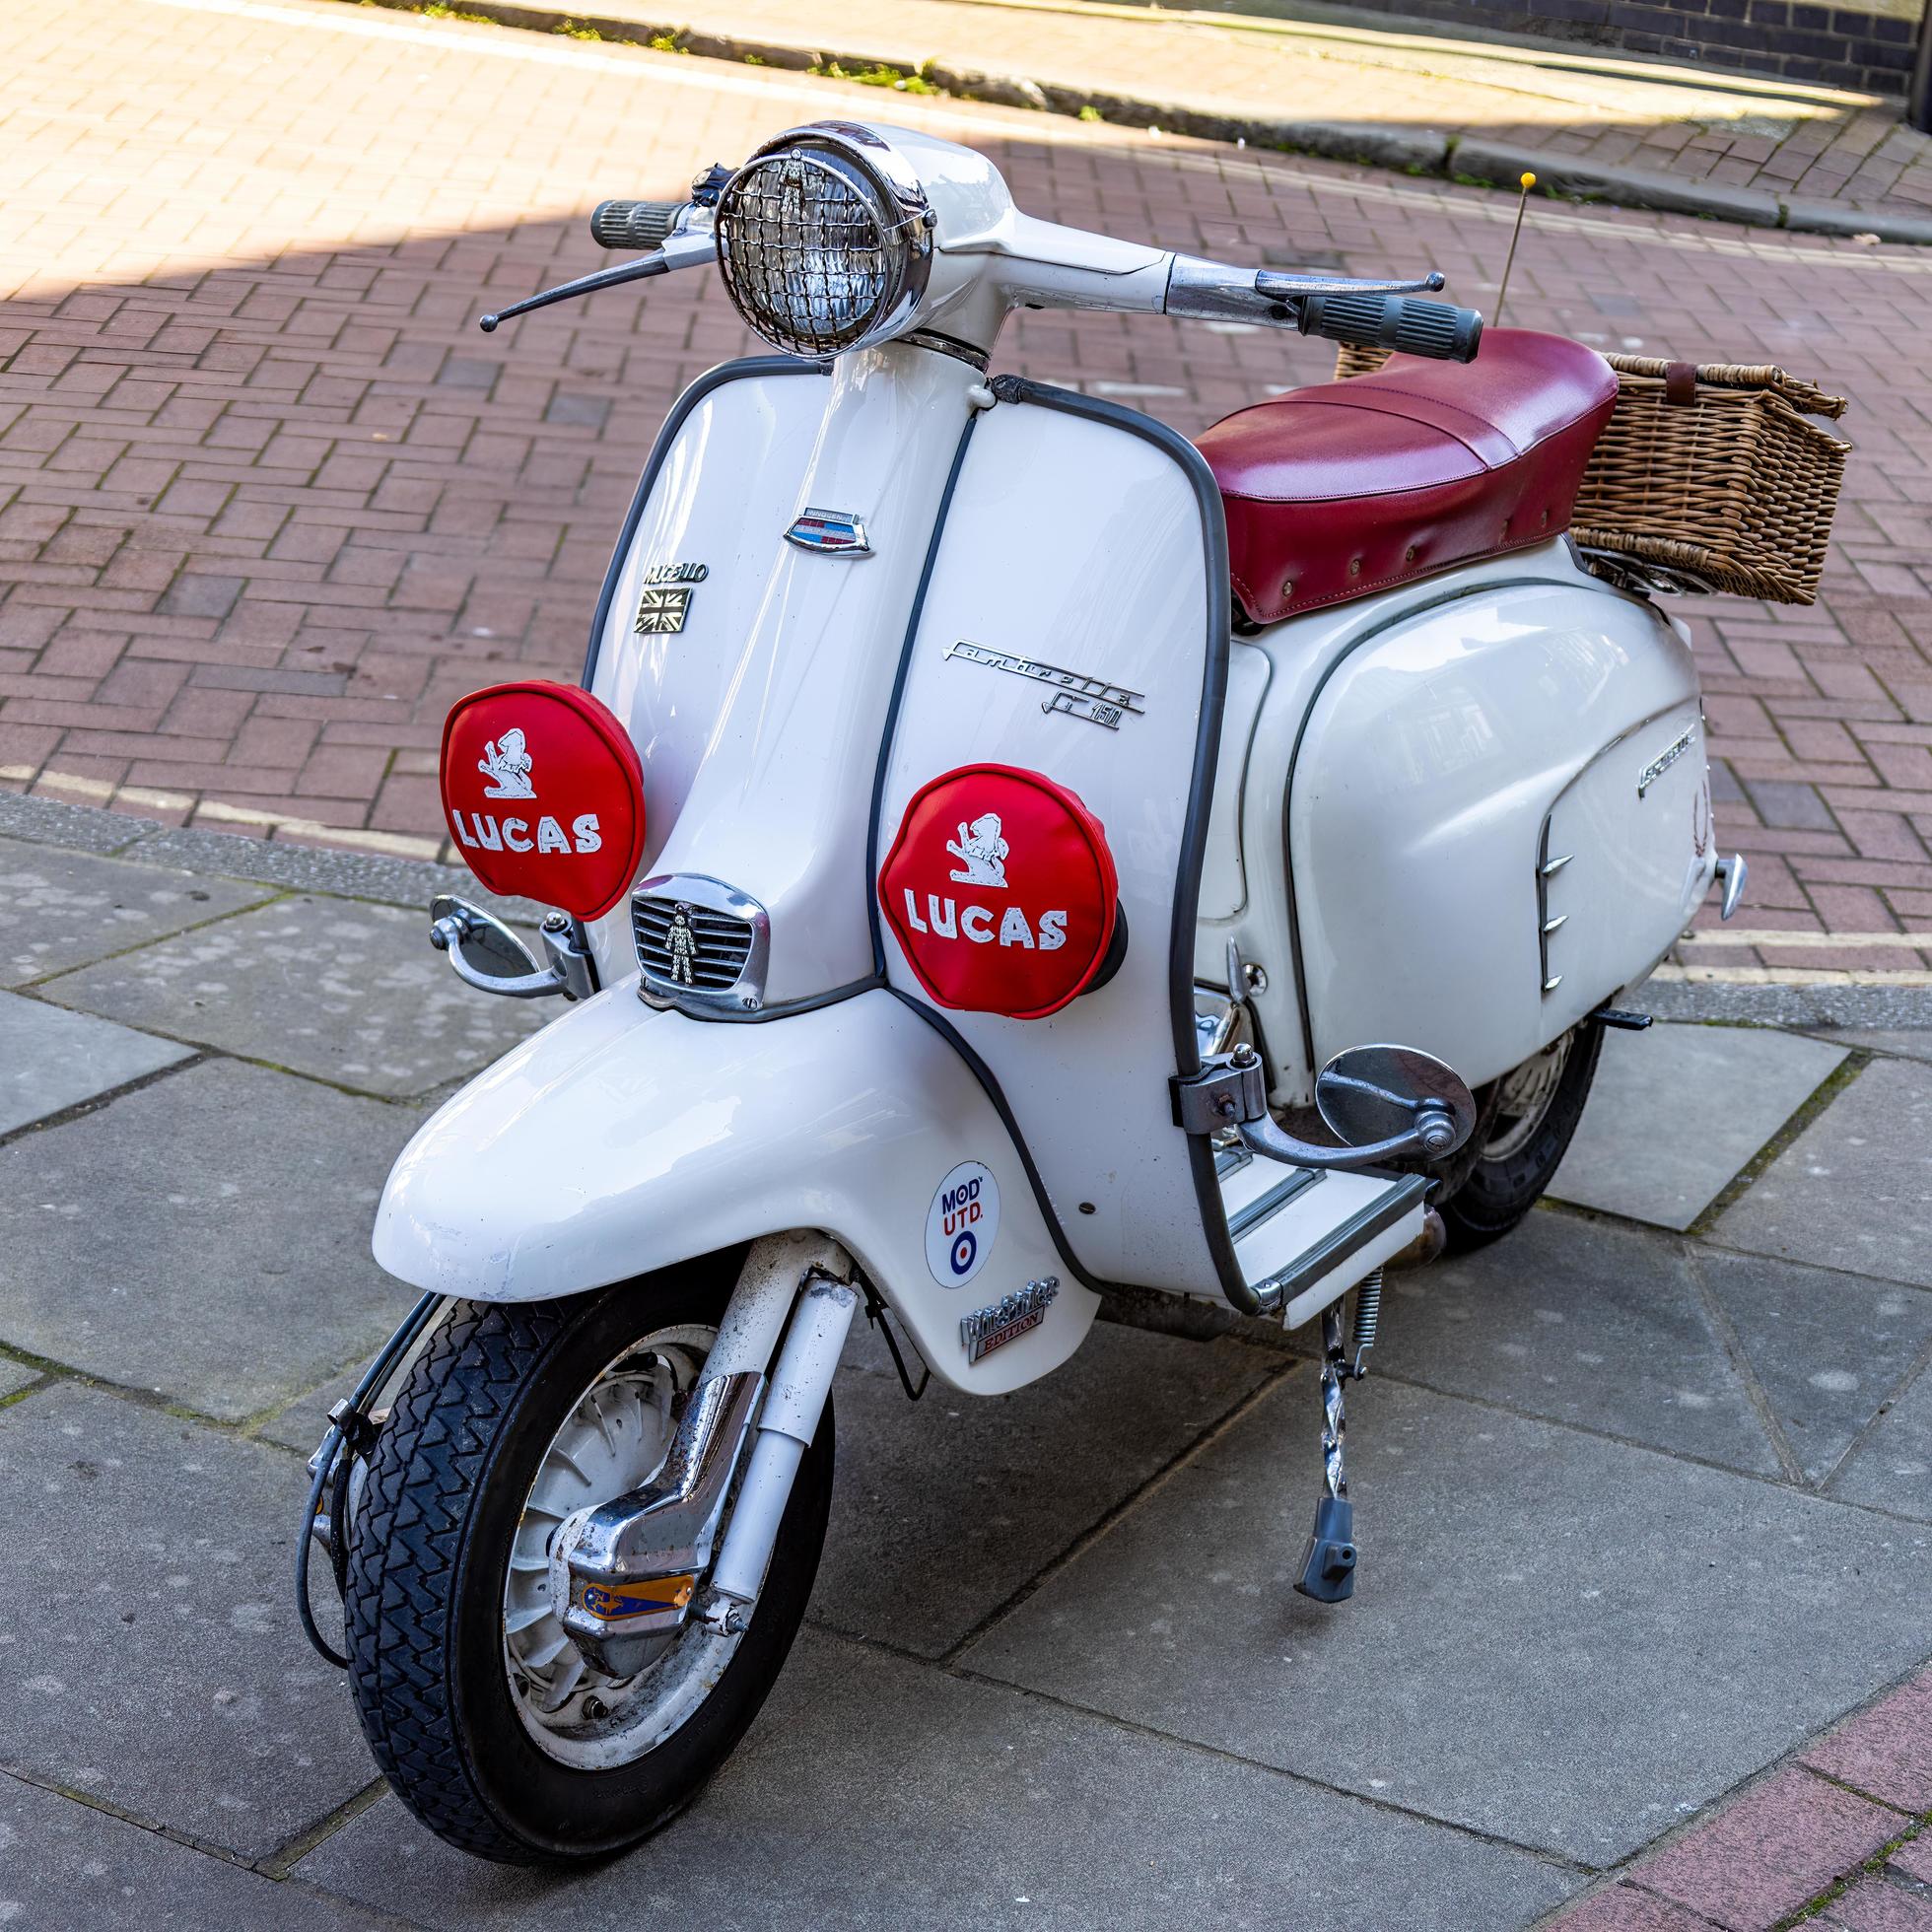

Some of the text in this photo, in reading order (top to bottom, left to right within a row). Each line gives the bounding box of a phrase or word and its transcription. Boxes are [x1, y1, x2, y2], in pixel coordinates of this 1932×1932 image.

[1091, 702, 1123, 727] 150
[452, 809, 602, 854] LUCAS
[904, 888, 1068, 950] LUCAS
[943, 1202, 984, 1236] UTD.
[984, 1311, 1040, 1352] EDITION
